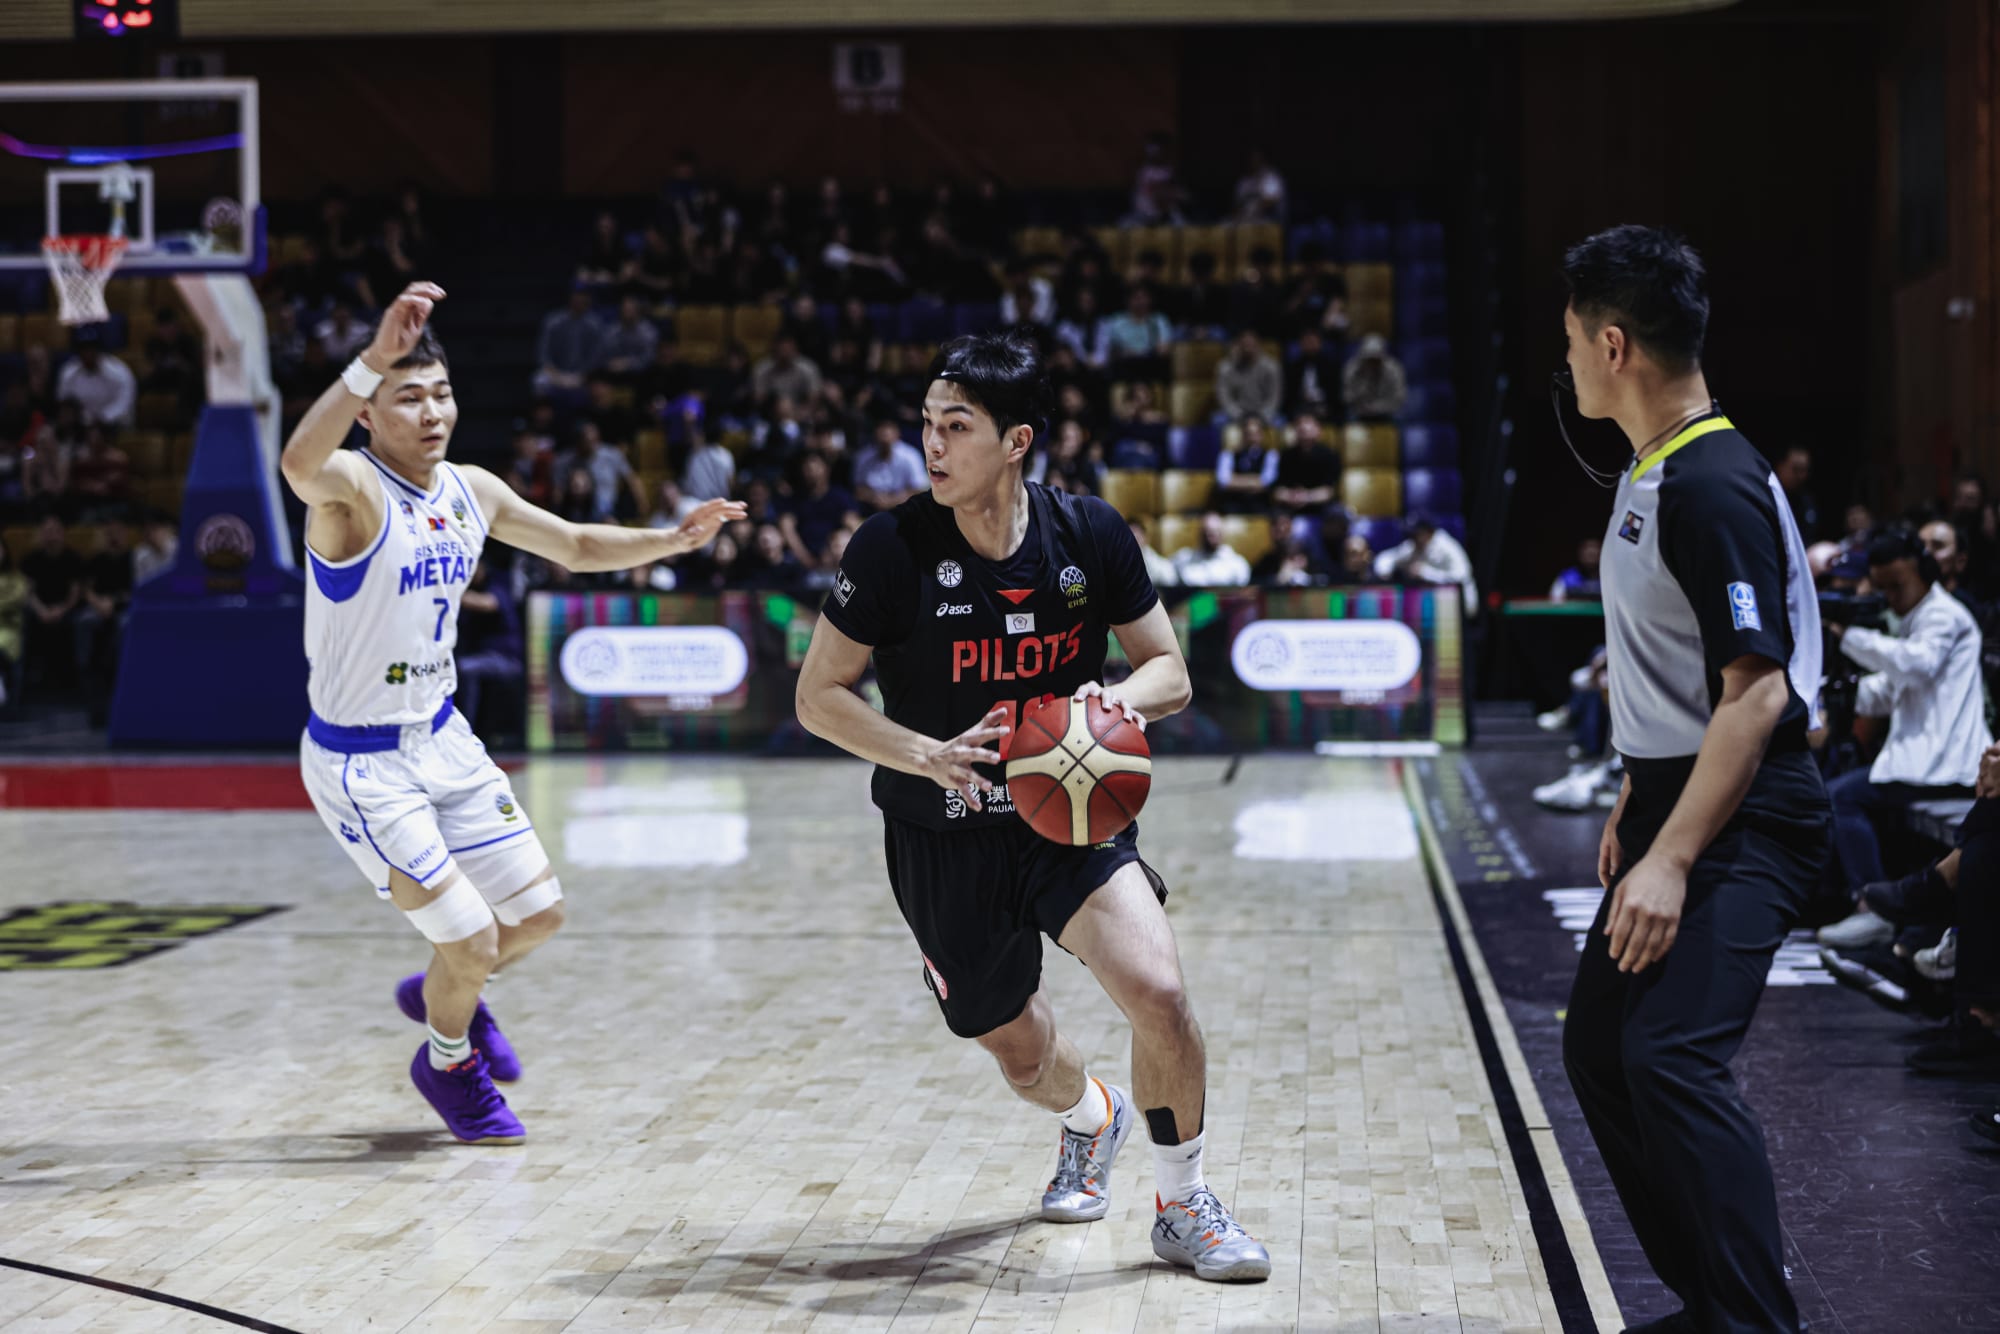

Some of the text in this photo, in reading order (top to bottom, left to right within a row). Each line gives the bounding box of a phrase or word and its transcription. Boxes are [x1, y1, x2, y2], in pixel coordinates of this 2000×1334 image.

[433, 598, 450, 642] 7
[948, 604, 973, 615] asics
[953, 621, 1084, 683] PILOTS
[986, 783, 1012, 804] 璞
